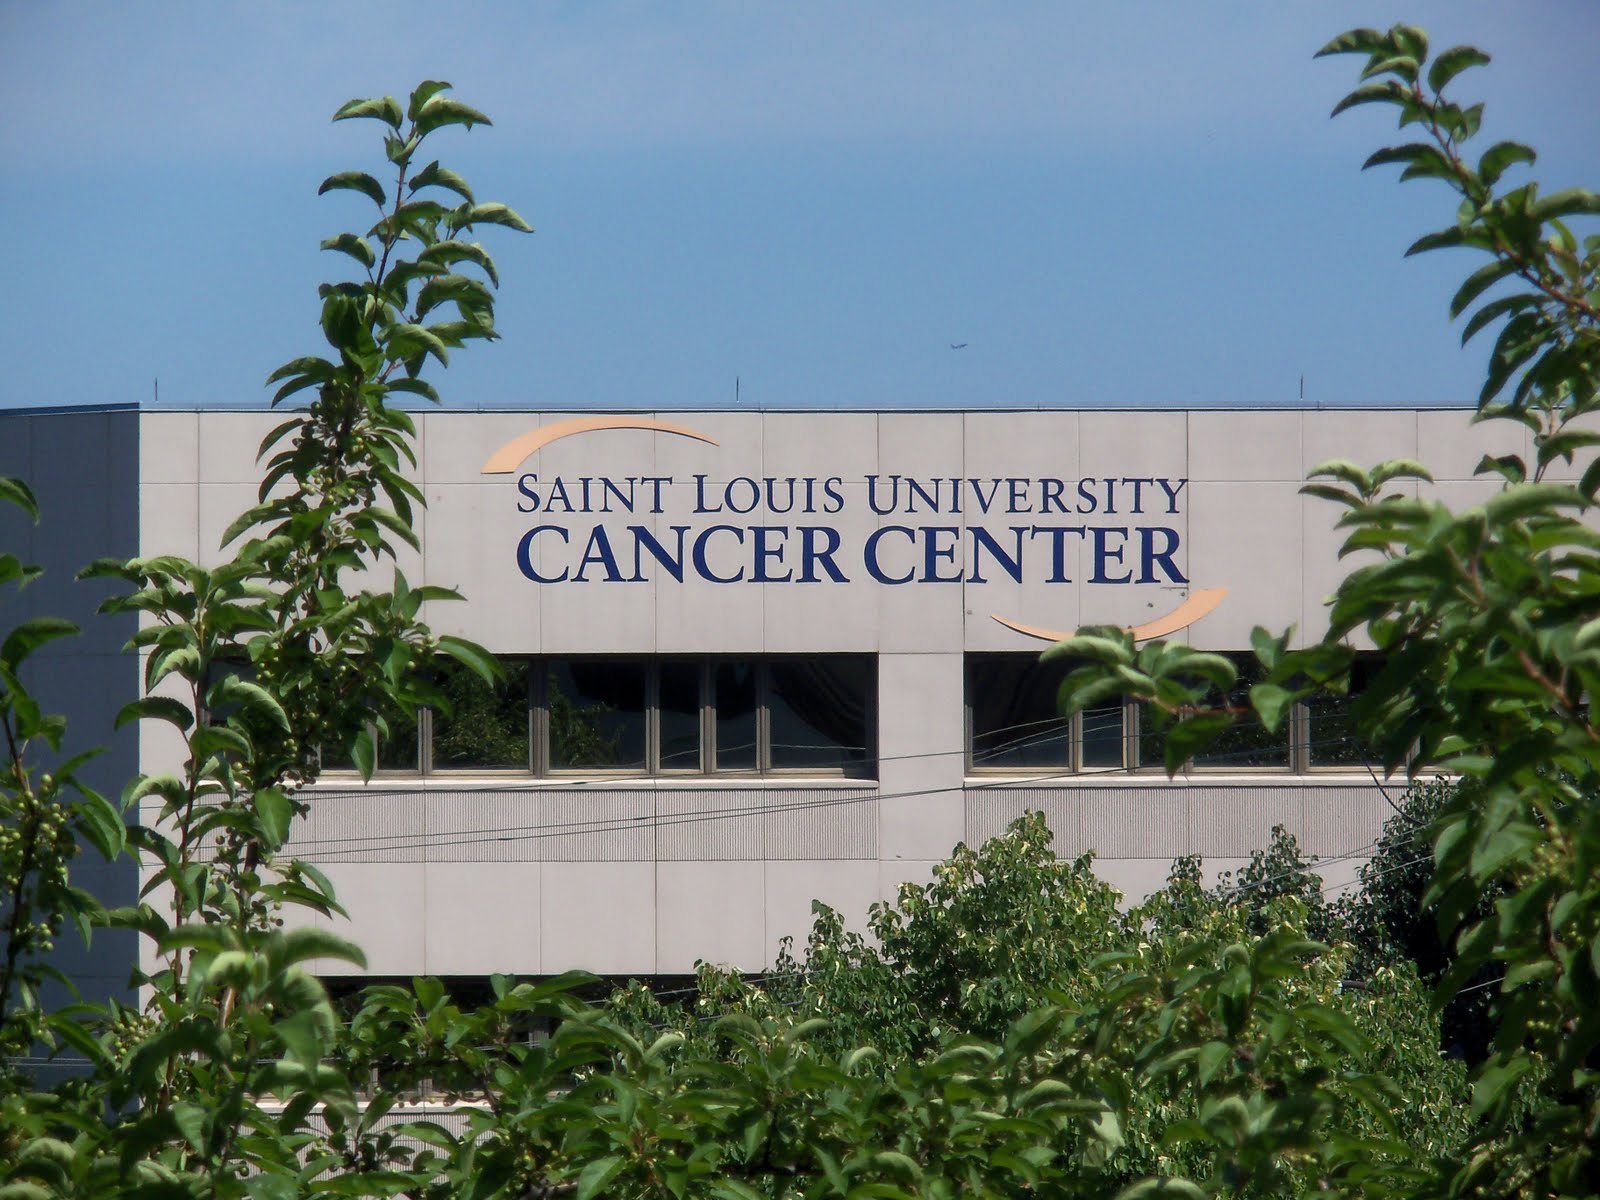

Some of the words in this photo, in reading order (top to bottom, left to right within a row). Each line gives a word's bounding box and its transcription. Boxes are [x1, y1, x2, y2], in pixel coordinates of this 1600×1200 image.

[517, 474, 673, 514] SAINT
[692, 475, 845, 514] LOUIS
[866, 474, 1189, 515] UNIVERSITY
[516, 525, 850, 584] CANCER
[864, 525, 1190, 584] CENTER
